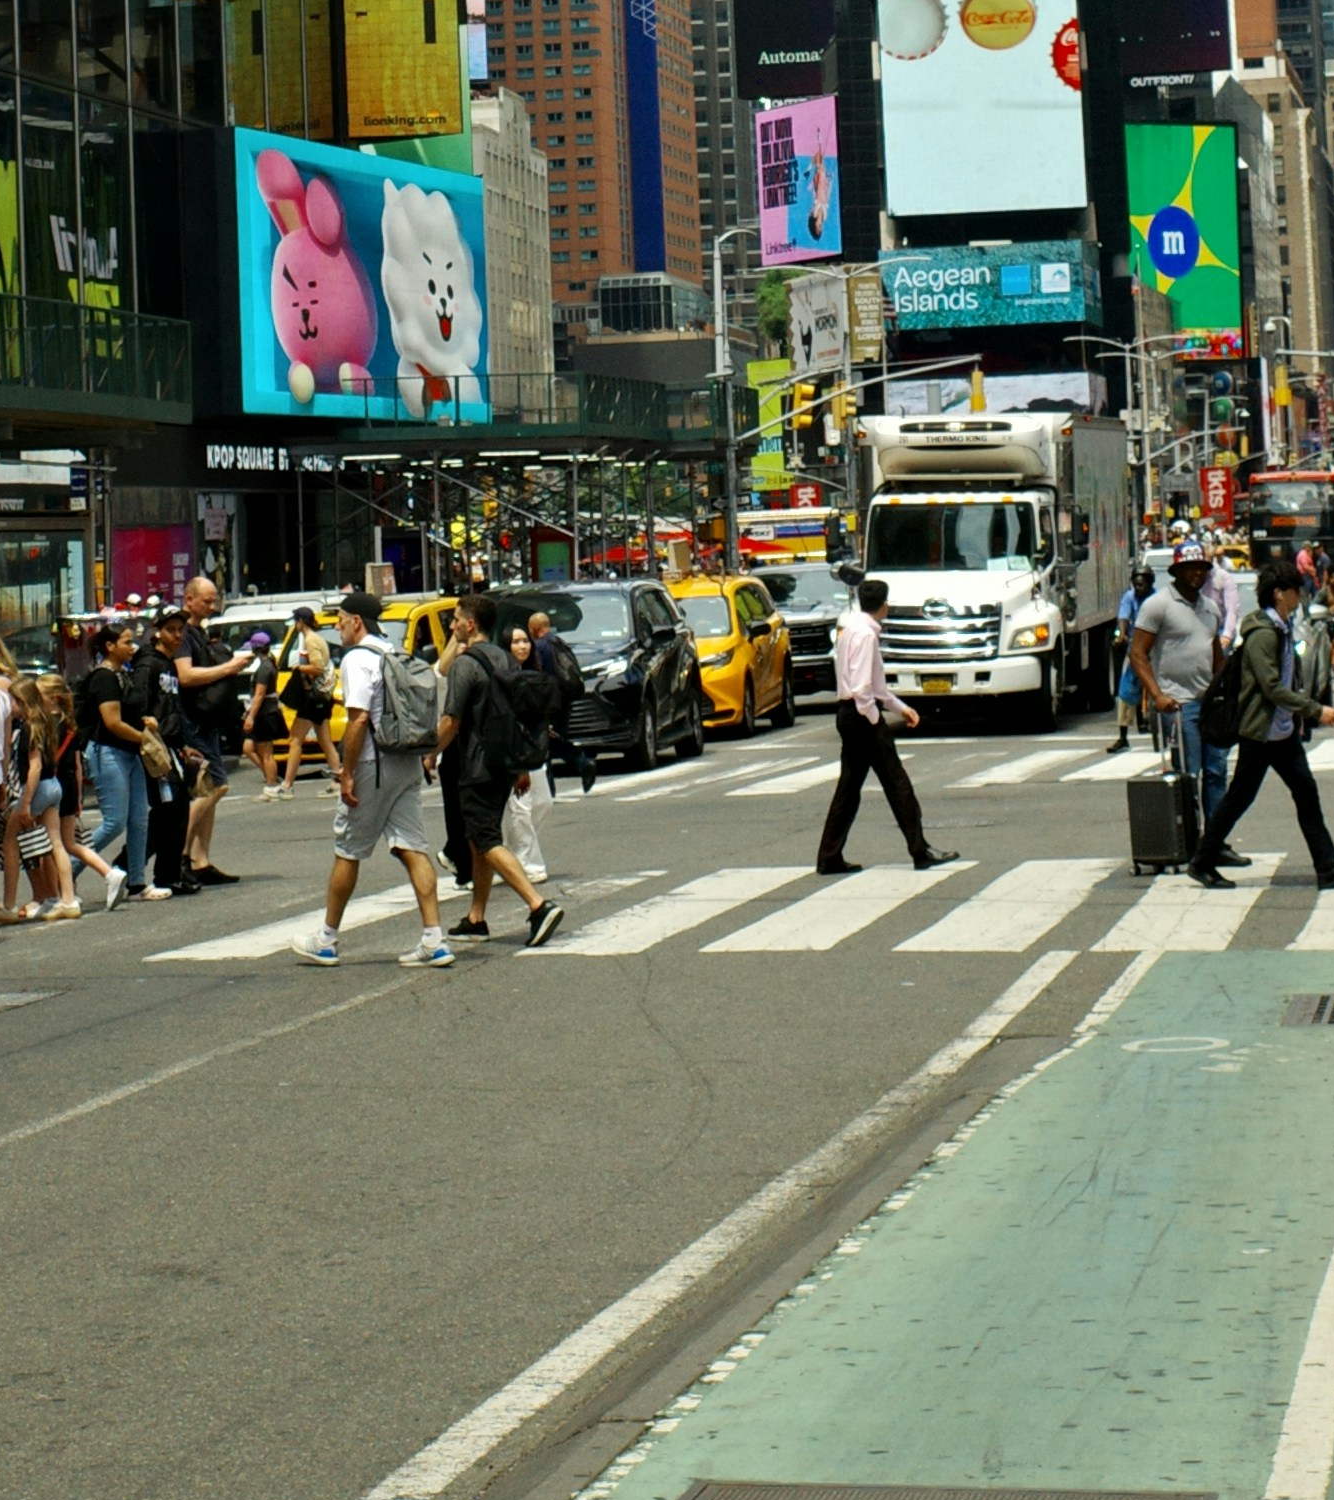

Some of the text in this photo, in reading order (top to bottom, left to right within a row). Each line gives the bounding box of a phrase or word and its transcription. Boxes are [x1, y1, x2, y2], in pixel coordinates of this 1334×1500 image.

[363, 111, 447, 128] lionking.com
[1163, 229, 1186, 255] m
[893, 264, 992, 294] Aegean
[894, 287, 979, 314] Islands
[925, 435, 988, 445] THERMO KING
[206, 443, 235, 470] KPOP
[236, 445, 275, 472] SQUARE
[1207, 468, 1227, 510] tkts
